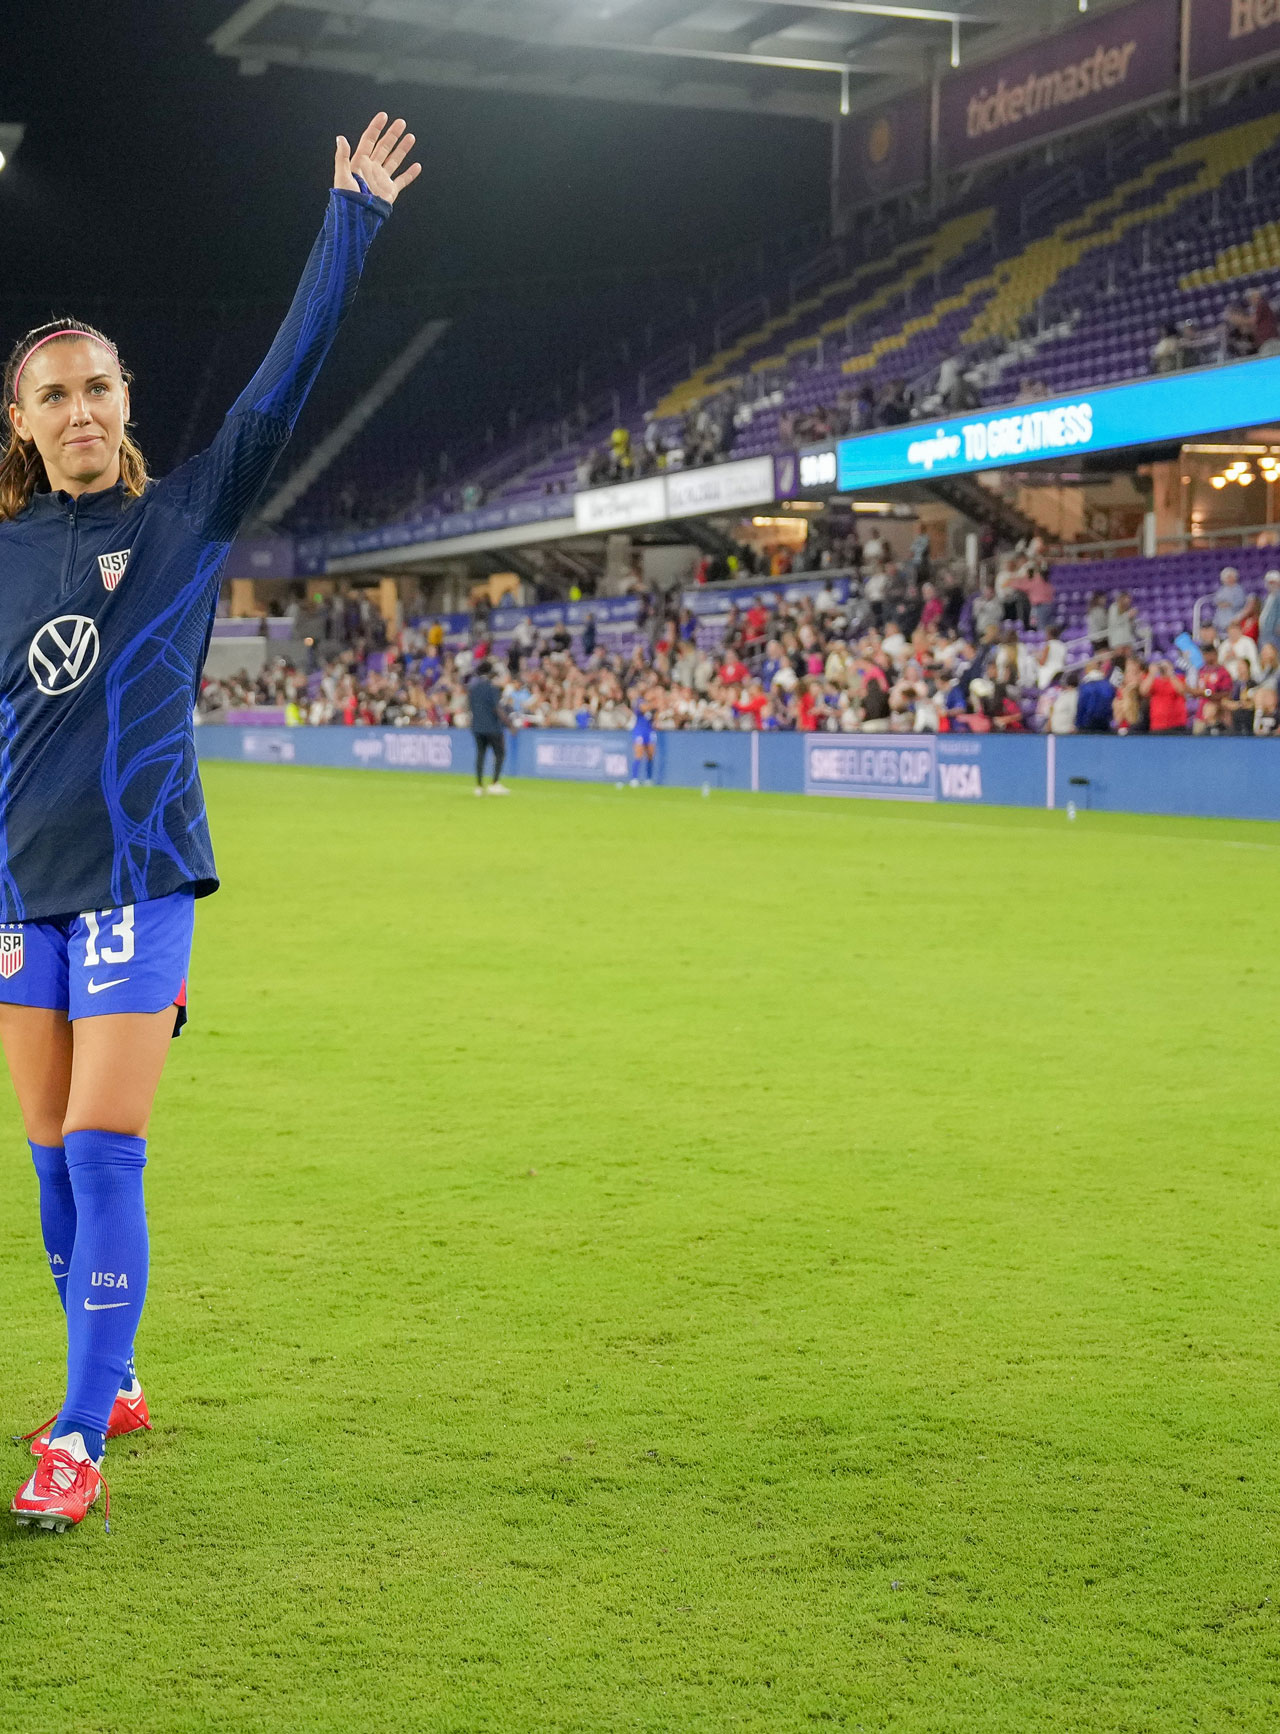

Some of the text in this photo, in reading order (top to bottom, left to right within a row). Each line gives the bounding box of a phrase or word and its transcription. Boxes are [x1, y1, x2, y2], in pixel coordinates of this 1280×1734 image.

[966, 41, 1137, 138] ticketmaster
[962, 423, 987, 461] TO
[987, 403, 1093, 458] GREATNESS
[938, 763, 982, 799] VISA
[79, 903, 135, 967] 13
[91, 1271, 129, 1289] USA
